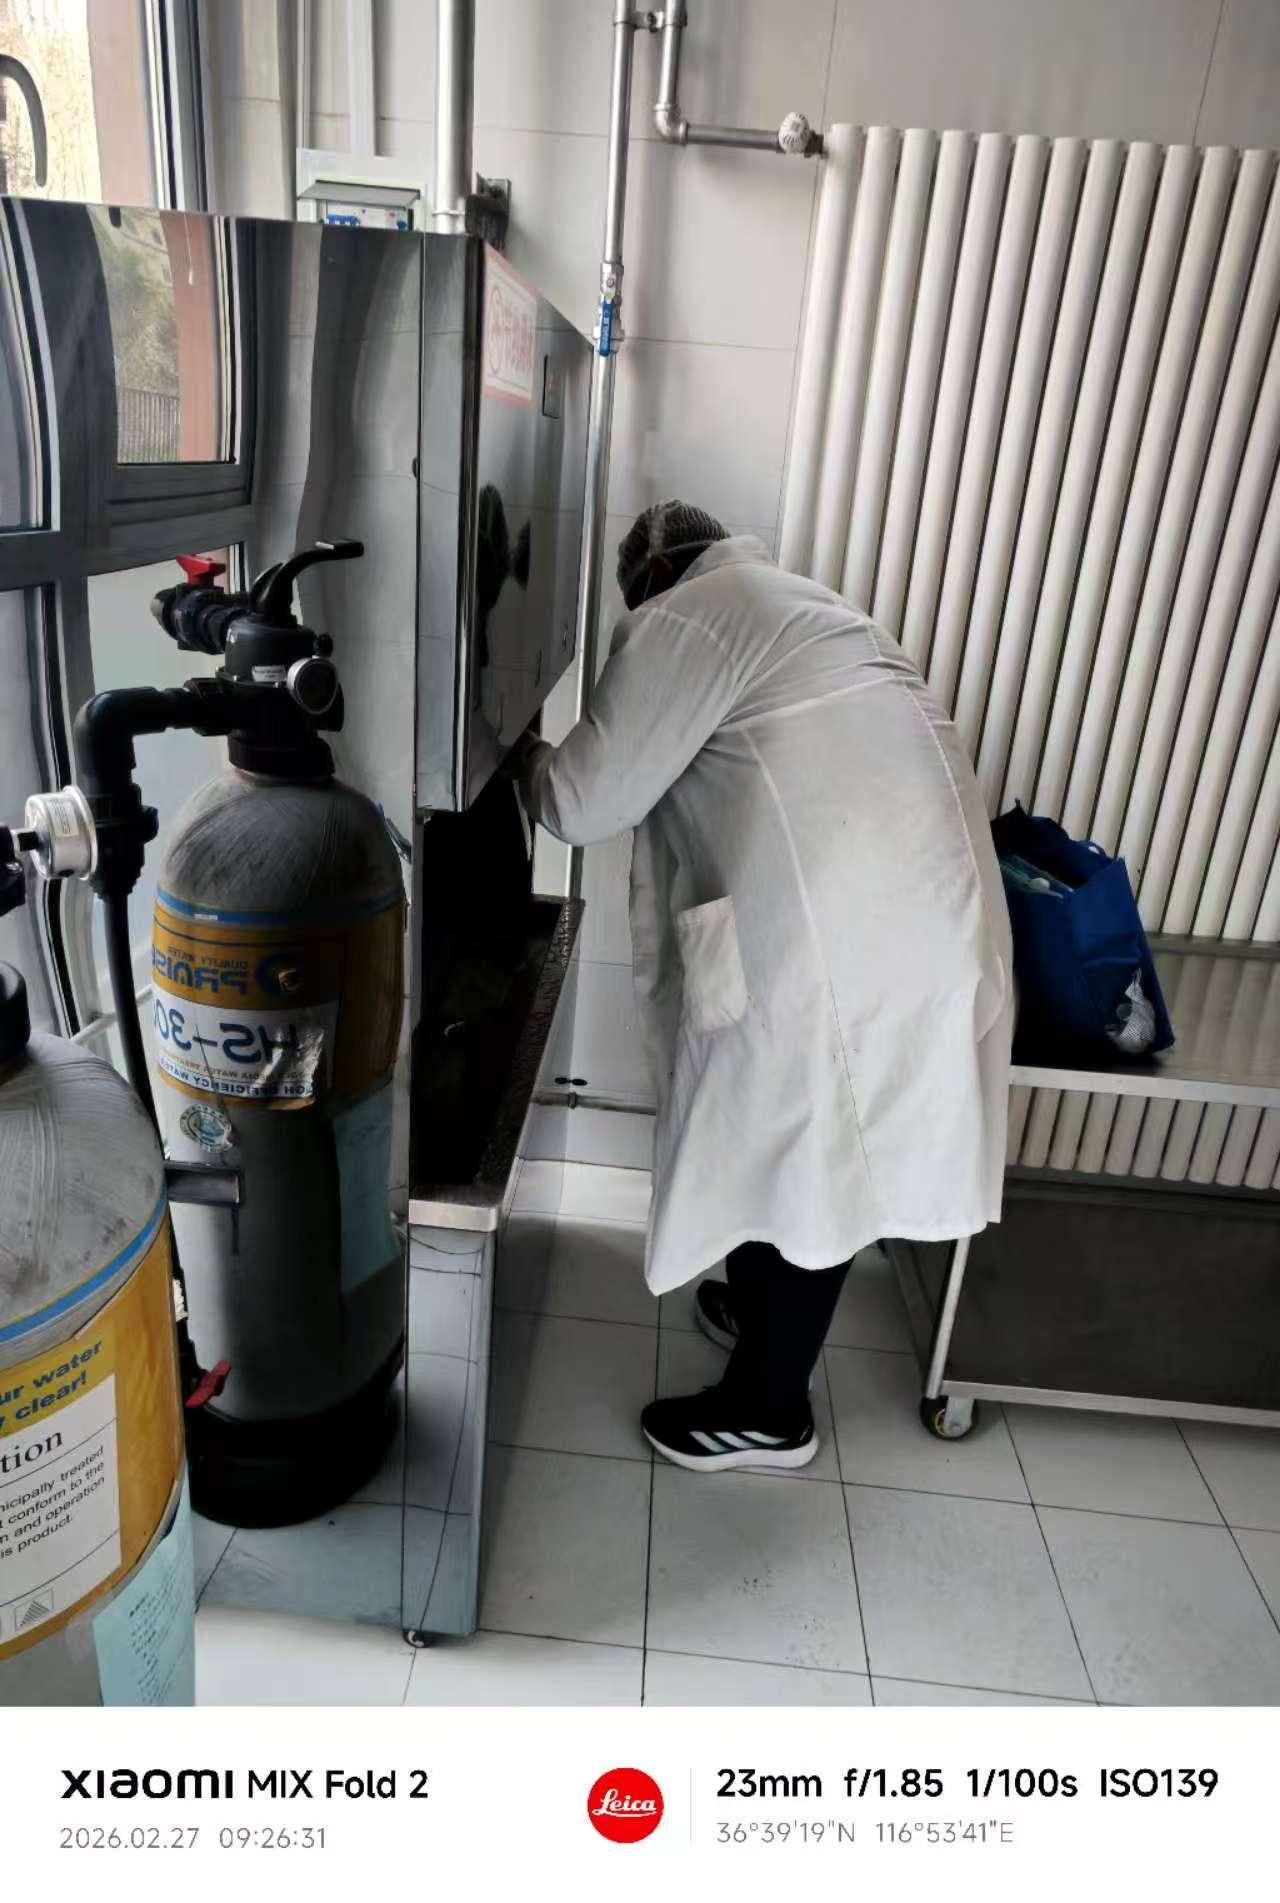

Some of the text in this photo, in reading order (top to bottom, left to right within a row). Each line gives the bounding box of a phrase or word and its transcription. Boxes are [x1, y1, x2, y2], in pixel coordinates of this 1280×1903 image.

[33, 1340, 102, 1388] water
[16, 1369, 86, 1419] clear!
[1, 1432, 62, 1474] tion
[60, 1445, 103, 1481] treated
[8, 1489, 66, 1524] conform
[70, 1478, 82, 1490] to
[85, 1462, 104, 1480] the
[14, 1515, 41, 1537] and
[45, 1477, 104, 1519] operation
